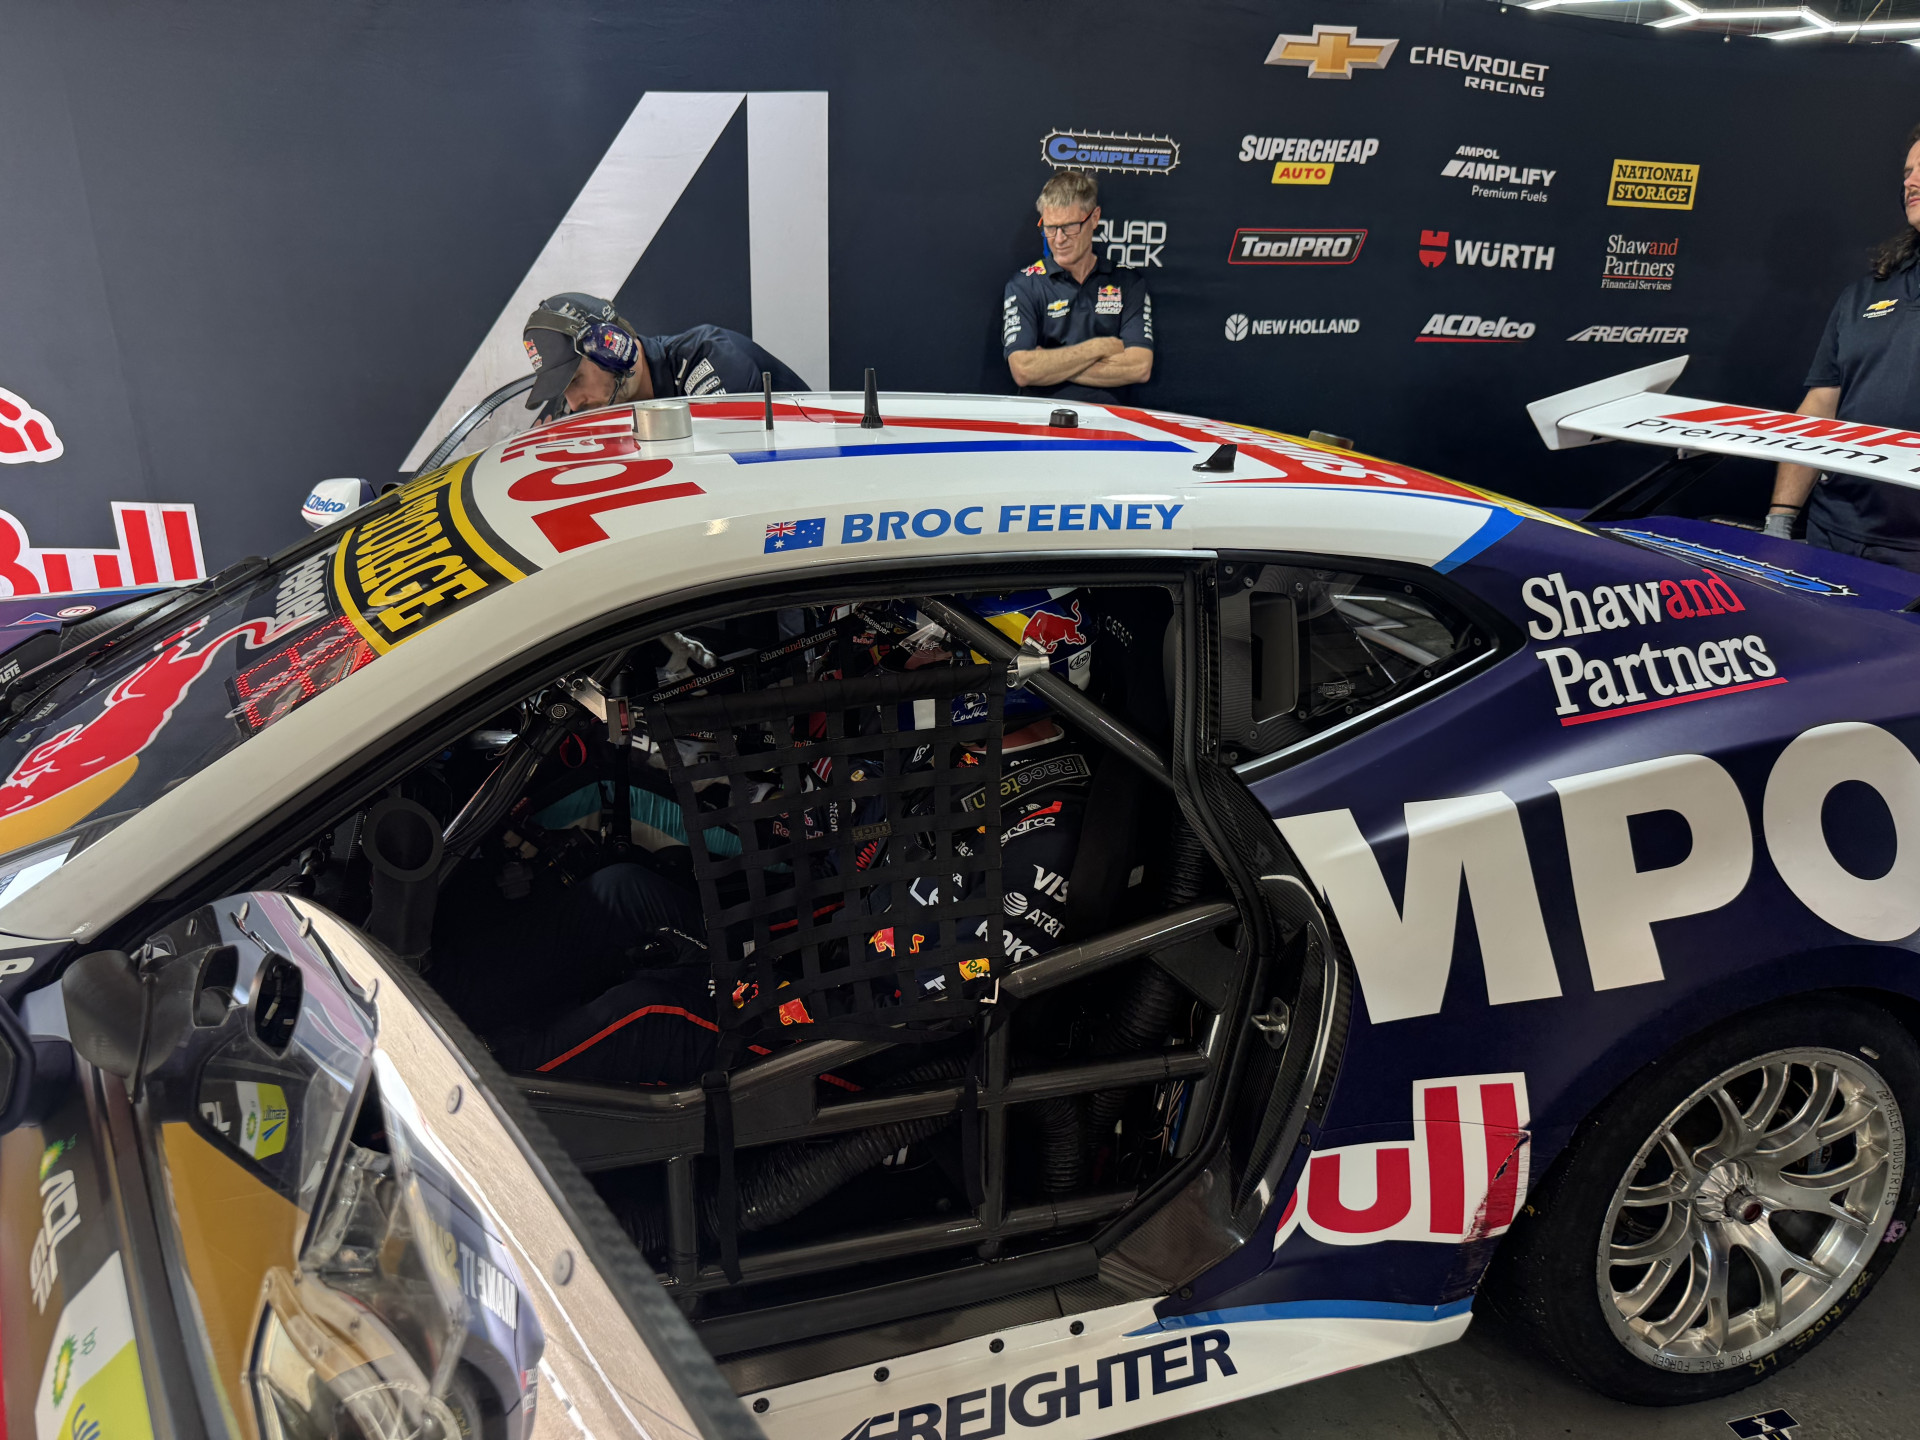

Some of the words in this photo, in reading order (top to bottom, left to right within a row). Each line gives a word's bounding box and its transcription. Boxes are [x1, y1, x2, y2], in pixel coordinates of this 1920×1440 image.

[1409, 46, 1549, 82] CHEVROLET
[1464, 75, 1545, 98] RACING
[1048, 137, 1172, 166] COMPLETE
[1238, 134, 1380, 164] SUPERCHEAP
[1455, 145, 1500, 160] AMPOL
[1278, 167, 1327, 180] AUTO
[1458, 161, 1557, 187] AMPLIFY
[1616, 164, 1694, 183] NATIONAL
[1471, 185, 1518, 200] Premium
[1520, 190, 1548, 203] Fuels
[1616, 183, 1688, 202] STORAGE
[1107, 244, 1165, 268] OCK
[1241, 233, 1355, 260] ToolPRO
[1454, 240, 1556, 271] WÜRTH
[1602, 255, 1675, 277] Partners
[1600, 279, 1638, 290] Financial
[1638, 280, 1672, 291] Services
[1251, 318, 1290, 336] NEW
[1294, 317, 1361, 335] HOLLAND
[1422, 313, 1537, 340] ACDelco
[1574, 325, 1690, 345] FREIGHTER
[1623, 418, 1889, 464] Premium
[840, 505, 984, 546] BROC
[997, 503, 1184, 533] FEENEY
[356, 491, 489, 633] STORAGE
[1535, 634, 1777, 716] Partners
[1024, 908, 1066, 939] AT&T
[1884, 1098, 1903, 1132] RACER
[1274, 1073, 1531, 1247] ull
[1884, 1133, 1906, 1207] INDUSTRIES
[1652, 1353, 1691, 1373] FORGED
[1699, 1359, 1725, 1372] RACE
[1731, 1352, 1752, 1365] PRO
